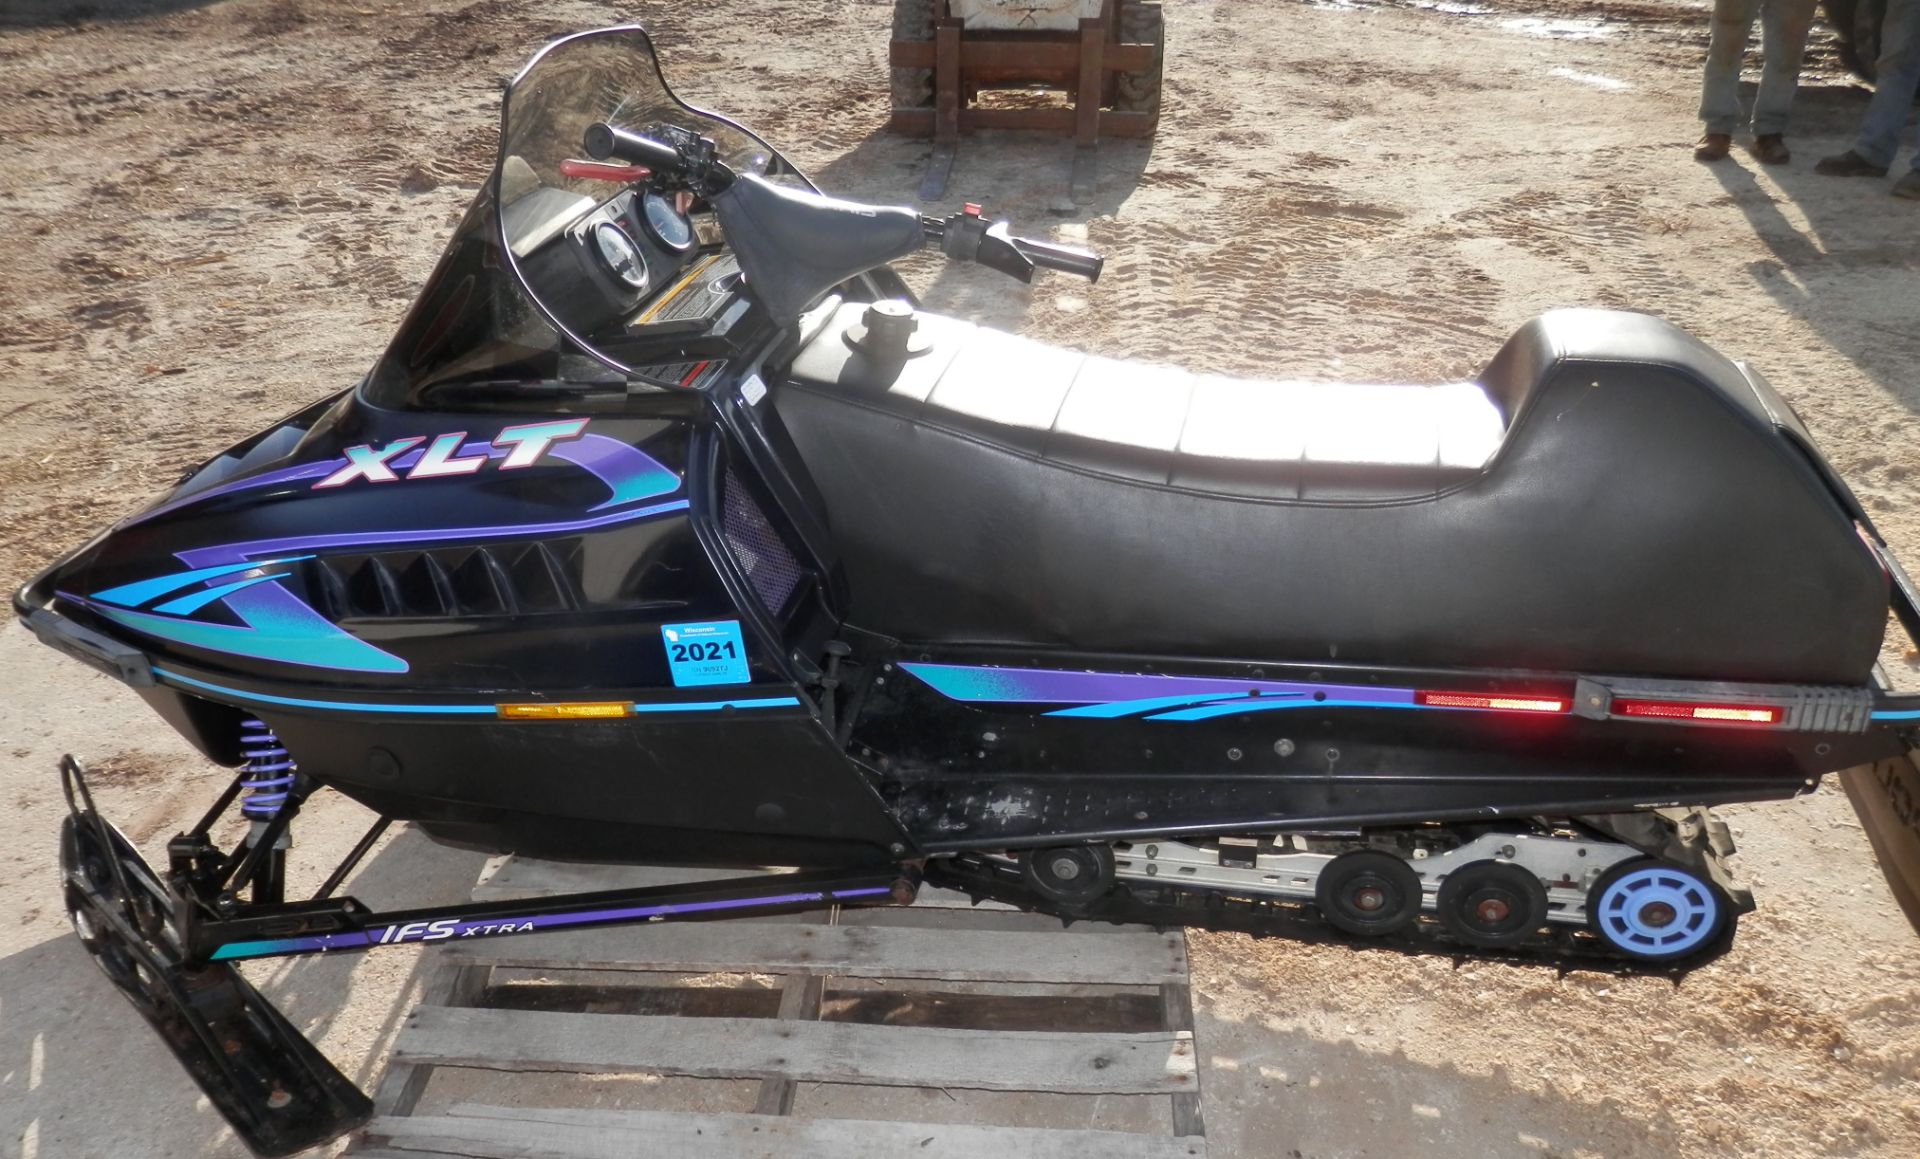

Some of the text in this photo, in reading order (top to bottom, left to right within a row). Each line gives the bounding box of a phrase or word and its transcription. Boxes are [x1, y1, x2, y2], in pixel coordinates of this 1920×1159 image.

[311, 417, 591, 490] XLT
[671, 640, 737, 662] 2021
[380, 918, 534, 944] IFS XTRA
